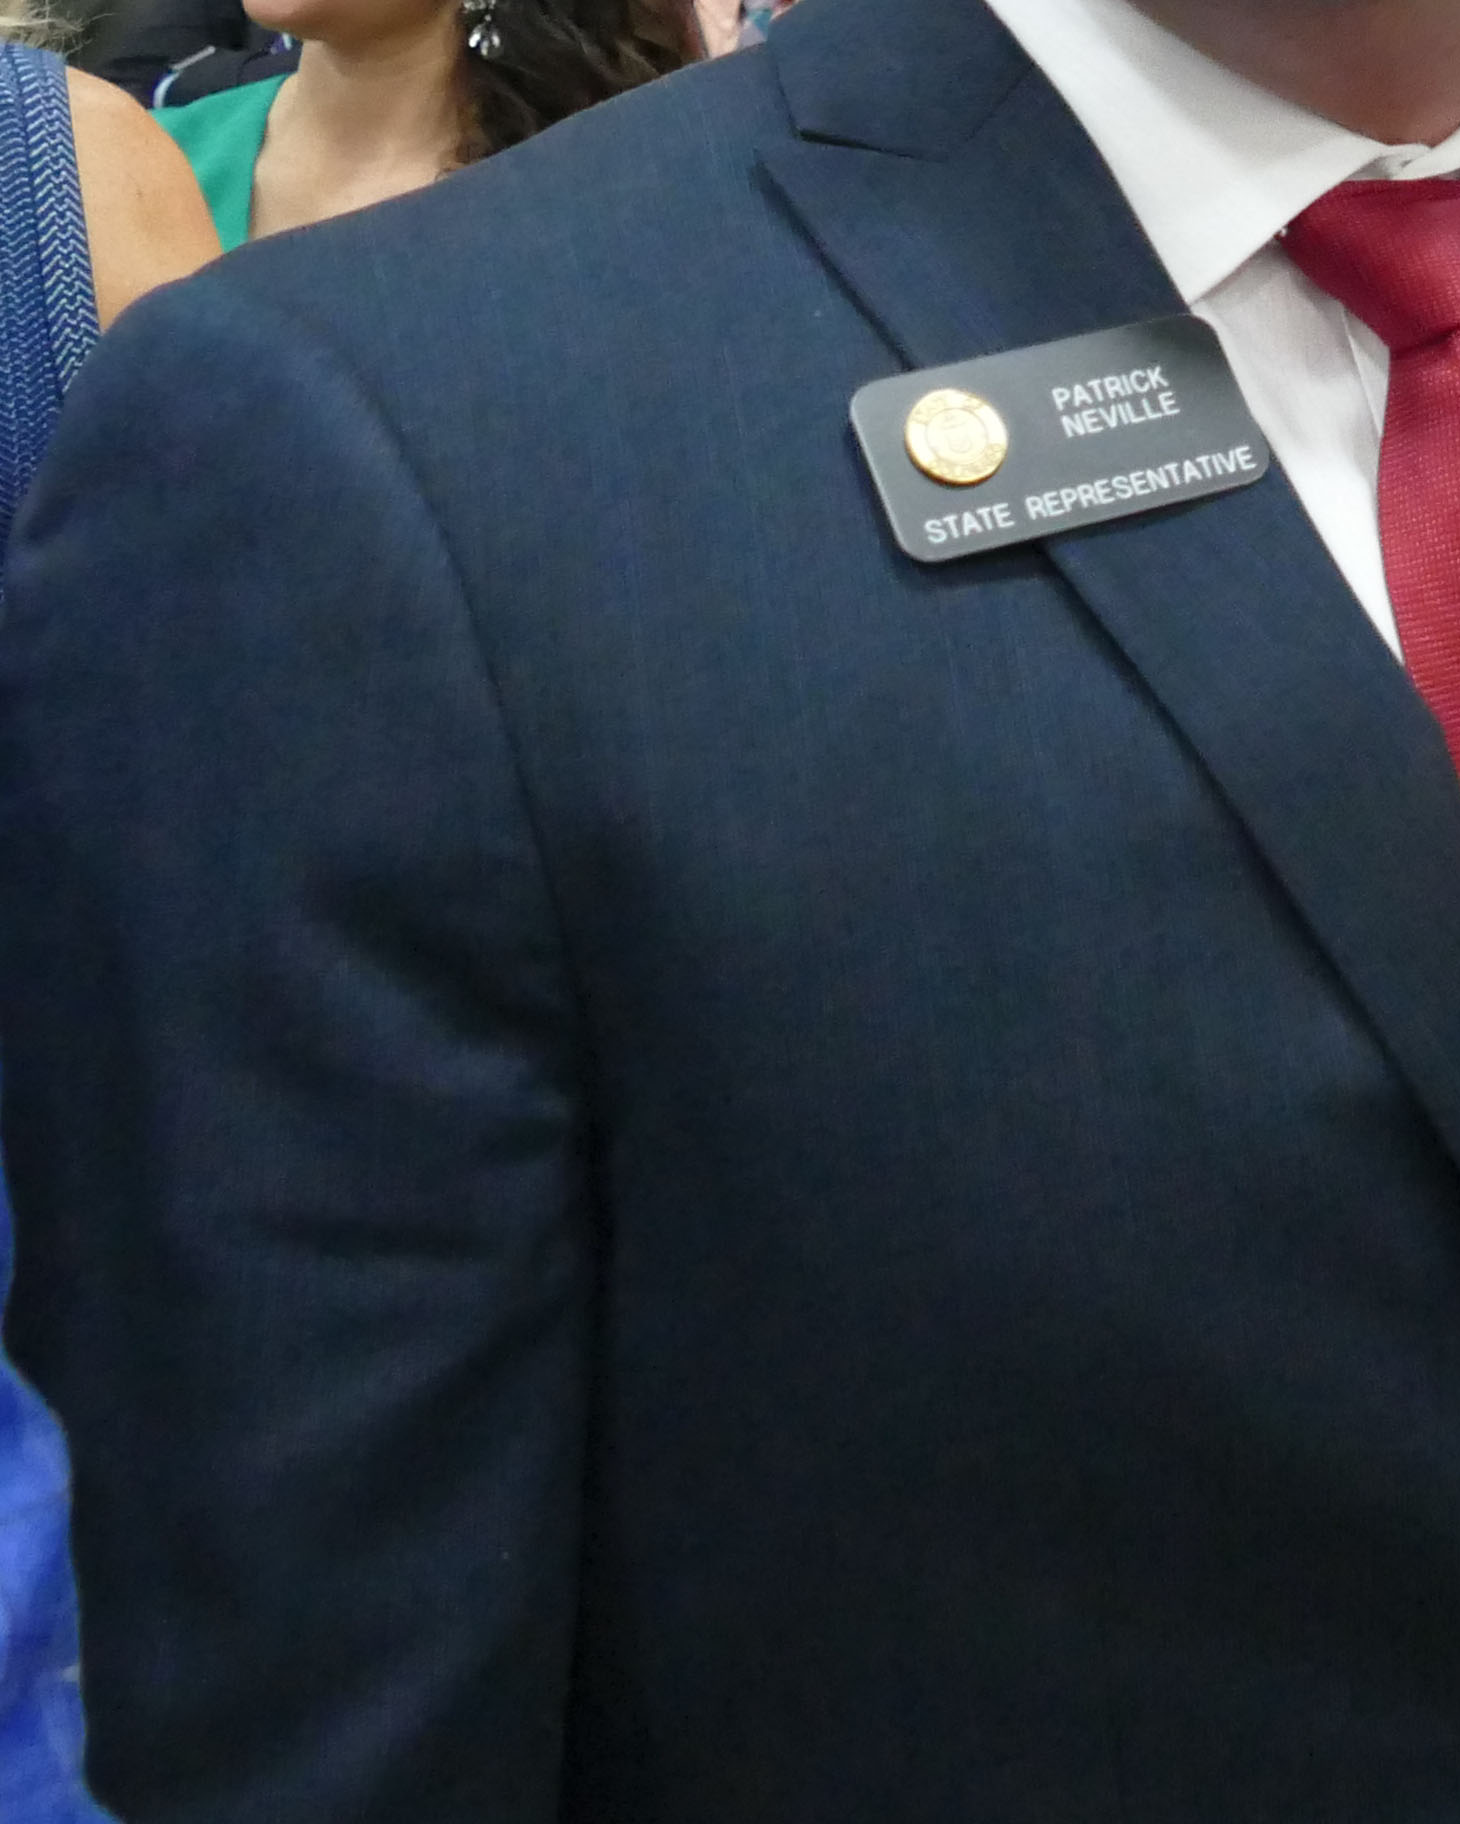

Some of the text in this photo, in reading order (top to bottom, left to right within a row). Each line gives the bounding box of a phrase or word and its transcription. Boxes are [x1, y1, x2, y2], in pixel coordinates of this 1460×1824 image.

[1051, 365, 1170, 411] PATRICK
[1060, 392, 1181, 439] NEVILLE
[923, 445, 1258, 545] STATE REPRESENTATIVE
